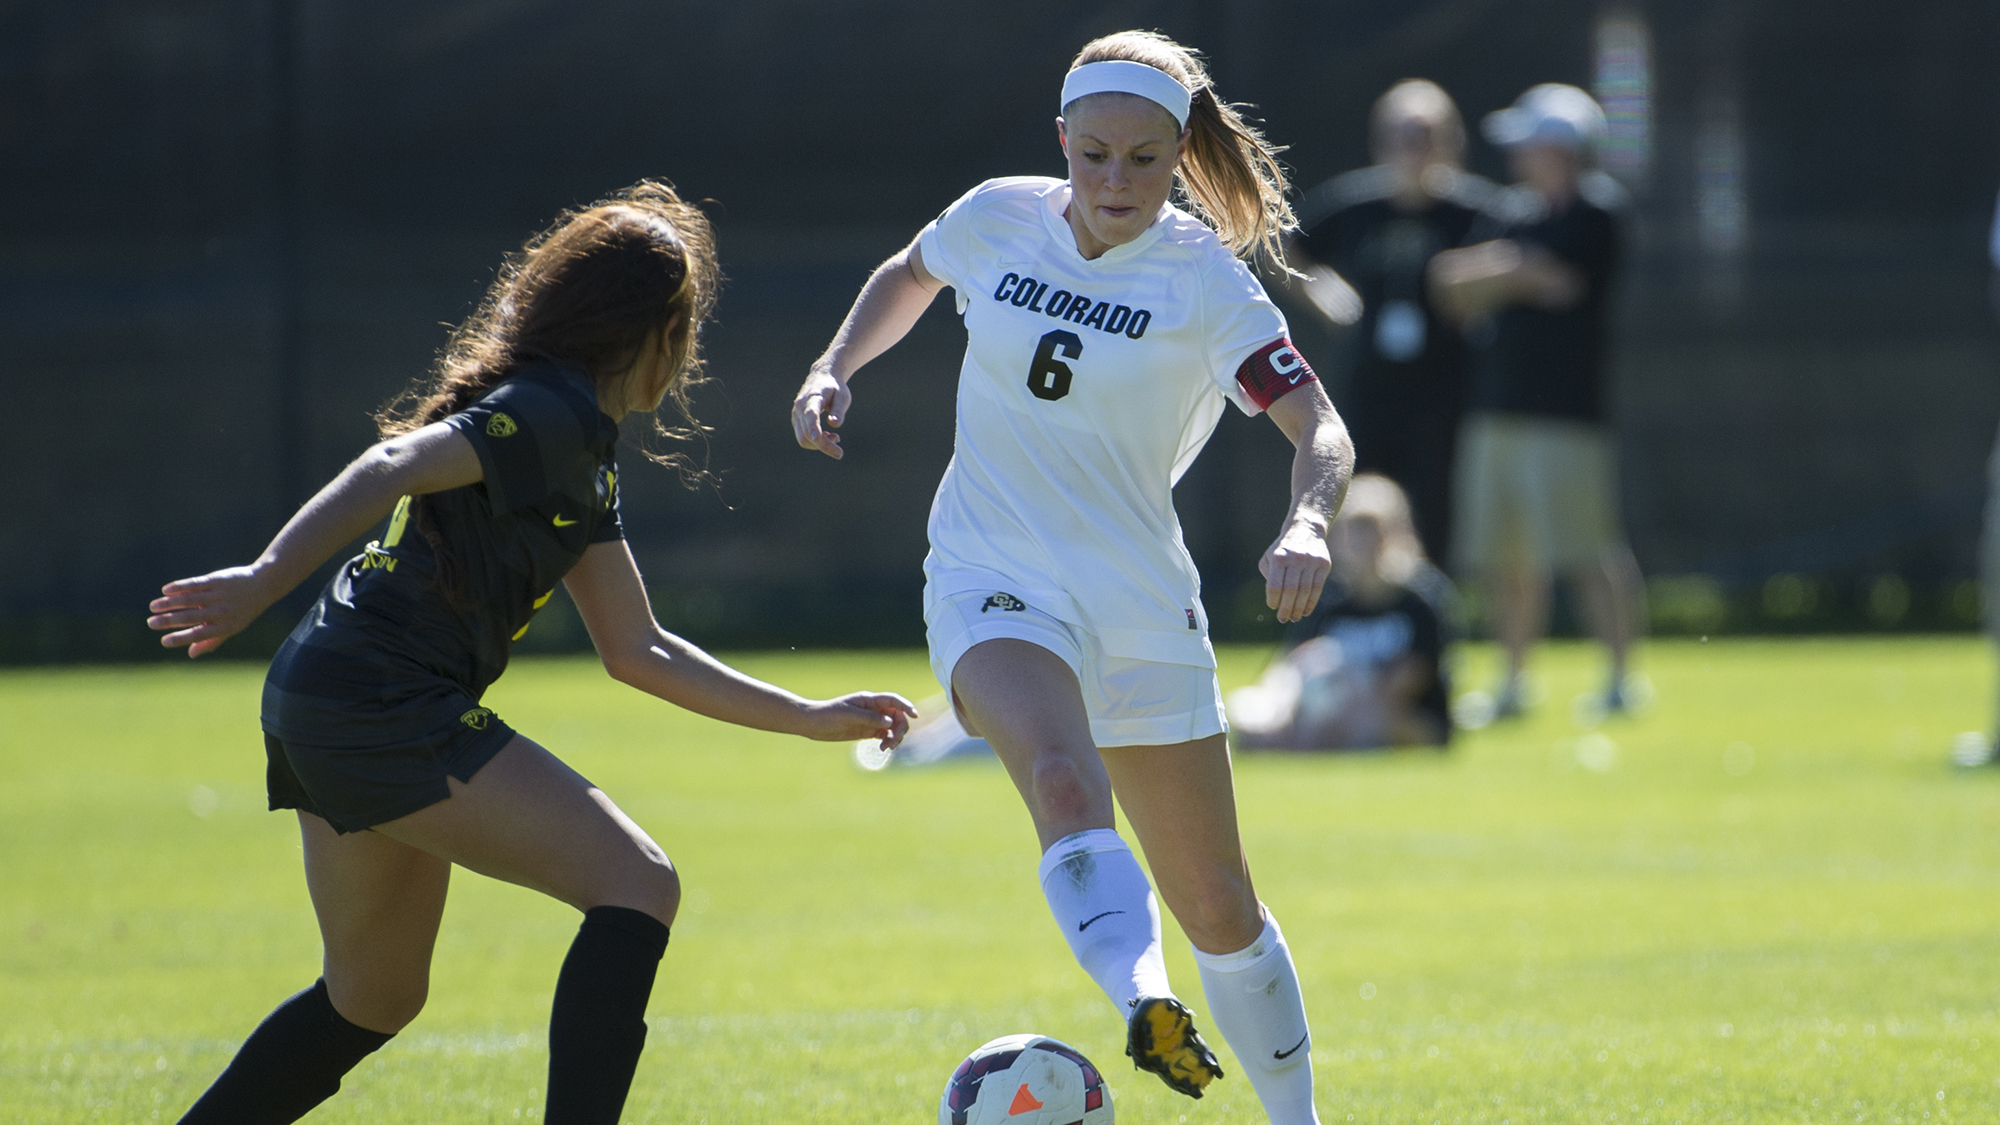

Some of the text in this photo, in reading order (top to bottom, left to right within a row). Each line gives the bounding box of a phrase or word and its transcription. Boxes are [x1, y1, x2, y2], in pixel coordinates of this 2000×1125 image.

[994, 272, 1152, 340] COLORADO
[1026, 329, 1084, 401] 6
[1268, 346, 1301, 375] C
